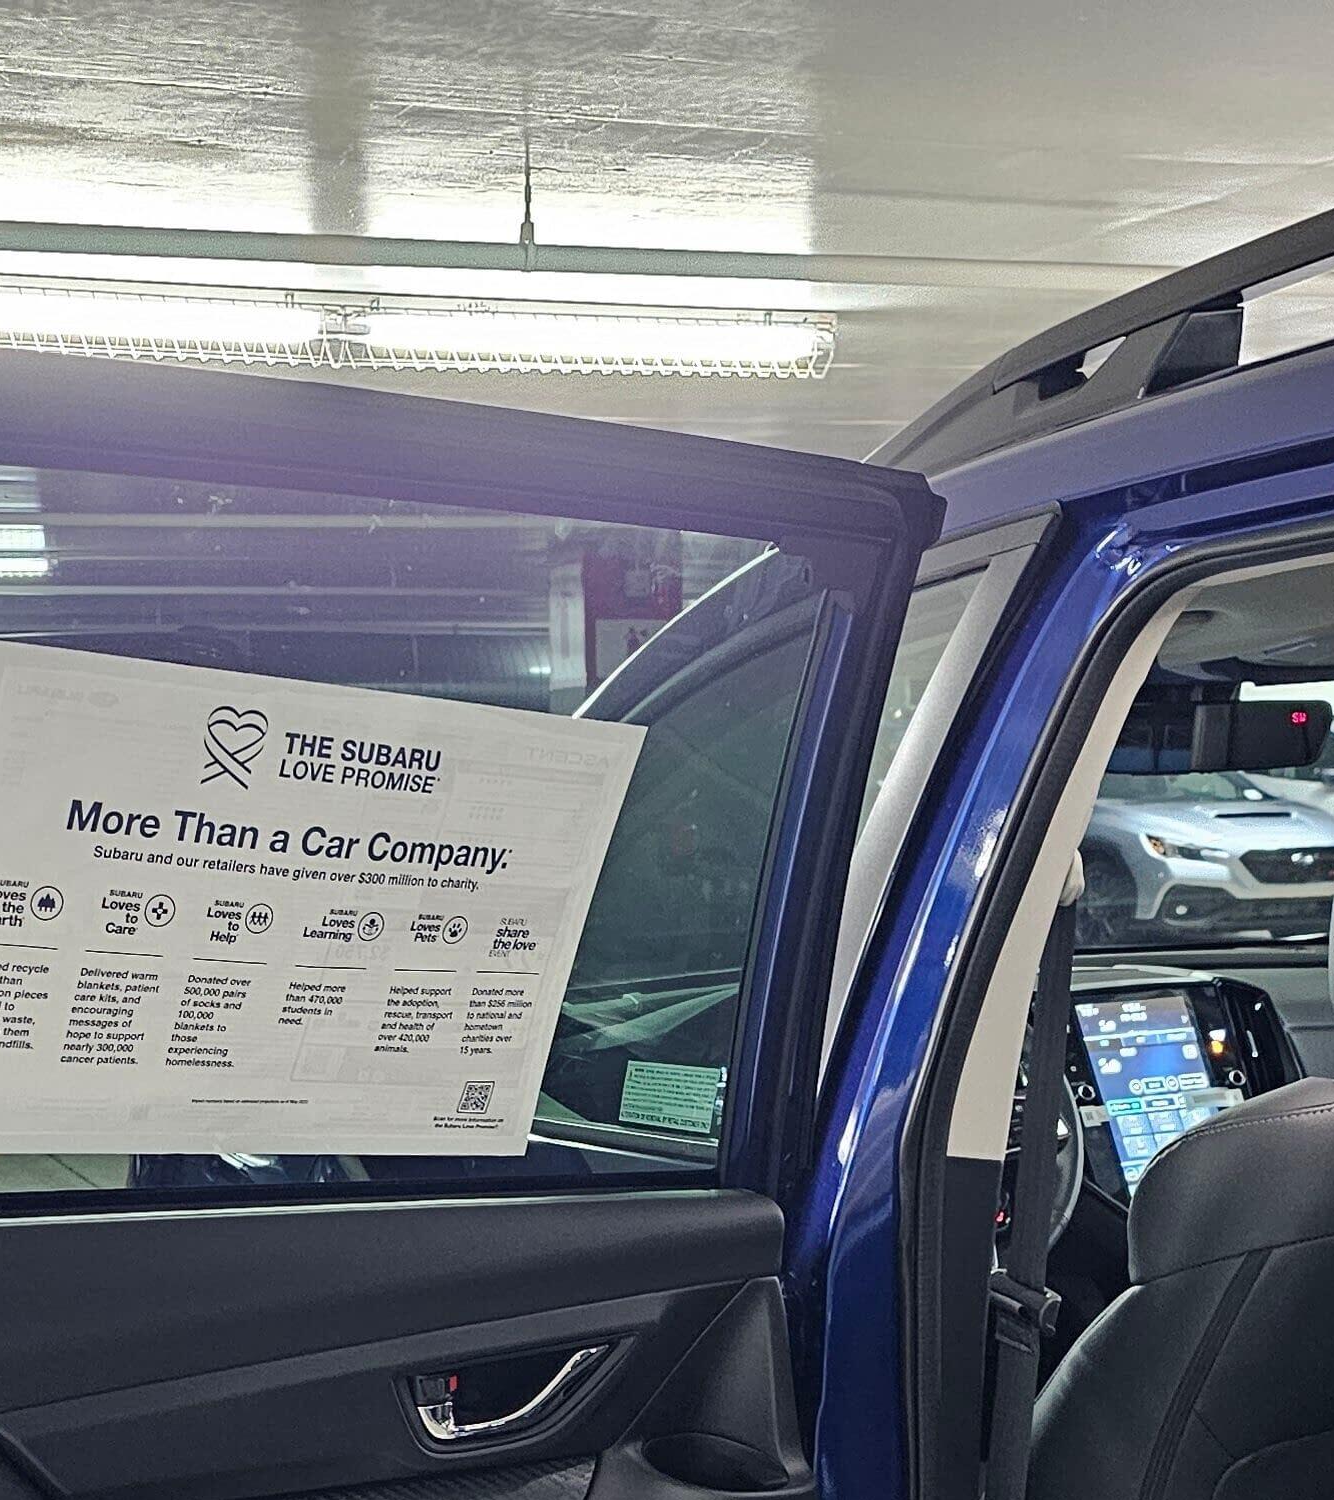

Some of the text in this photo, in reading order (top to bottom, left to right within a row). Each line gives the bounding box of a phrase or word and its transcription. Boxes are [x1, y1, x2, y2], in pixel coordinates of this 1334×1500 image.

[285, 732, 441, 773] THE SUBARU
[279, 759, 437, 794] LOVE PROMISE
[67, 799, 507, 874] More Than a Car Company.
[94, 846, 478, 892] Subaru and our retailers have given over $300 million to charity.
[109, 890, 143, 899] SUBARU
[2, 901, 24, 914] the
[102, 897, 140, 912] Loves
[214, 900, 244, 908] SUBARU
[126, 913, 138, 924] to
[207, 907, 241, 920] Loves
[228, 921, 239, 931] to
[322, 916, 355, 928] Loves
[410, 921, 441, 932] Loves
[106, 922, 136, 935] Care
[496, 926, 529, 938] share
[210, 931, 236, 944] Help
[303, 927, 353, 942] Learning
[414, 932, 437, 942] Pets
[493, 938, 536, 950] the love
[12, 965, 49, 975] recycle
[81, 968, 158, 981] Delivered warm
[0, 976, 22, 985] than
[188, 975, 228, 984] Donated
[77, 980, 159, 993] blankets, patient
[289, 982, 322, 992] Helped
[389, 986, 452, 997] Helped support
[14, 990, 48, 1000] pieces
[184, 987, 246, 999] 500,000 pairs
[472, 988, 504, 996] Donated
[99, 994, 119, 1004] kits,
[122, 996, 141, 1004] and
[286, 994, 343, 1005] than 470,000
[402, 999, 439, 1009] adoption,
[4, 1002, 15, 1011] to
[193, 1000, 220, 1008] socks
[223, 1002, 242, 1010] and
[71, 1007, 134, 1018] encouraging
[179, 1010, 214, 1020] 100,000
[282, 1006, 333, 1016] students in
[416, 1011, 453, 1020] transport
[476, 1011, 506, 1019] national
[3, 1016, 35, 1025] waste,
[69, 1019, 132, 1029] messages of
[174, 1022, 226, 1032] blankets to
[398, 1022, 424, 1030] health
[426, 1022, 435, 1031] of
[464, 1023, 503, 1031] hometown
[3, 1028, 29, 1036] them
[66, 1030, 144, 1042] hope to support
[171, 1034, 197, 1042] those
[461, 1034, 493, 1042] charities
[63, 1043, 133, 1053] nearly 300,000
[168, 1046, 228, 1057] experiencing
[374, 1045, 409, 1053] animals.
[460, 1046, 492, 1056] 15 years.
[97, 1056, 138, 1066] patients.
[166, 1058, 234, 1067] homelessness.
